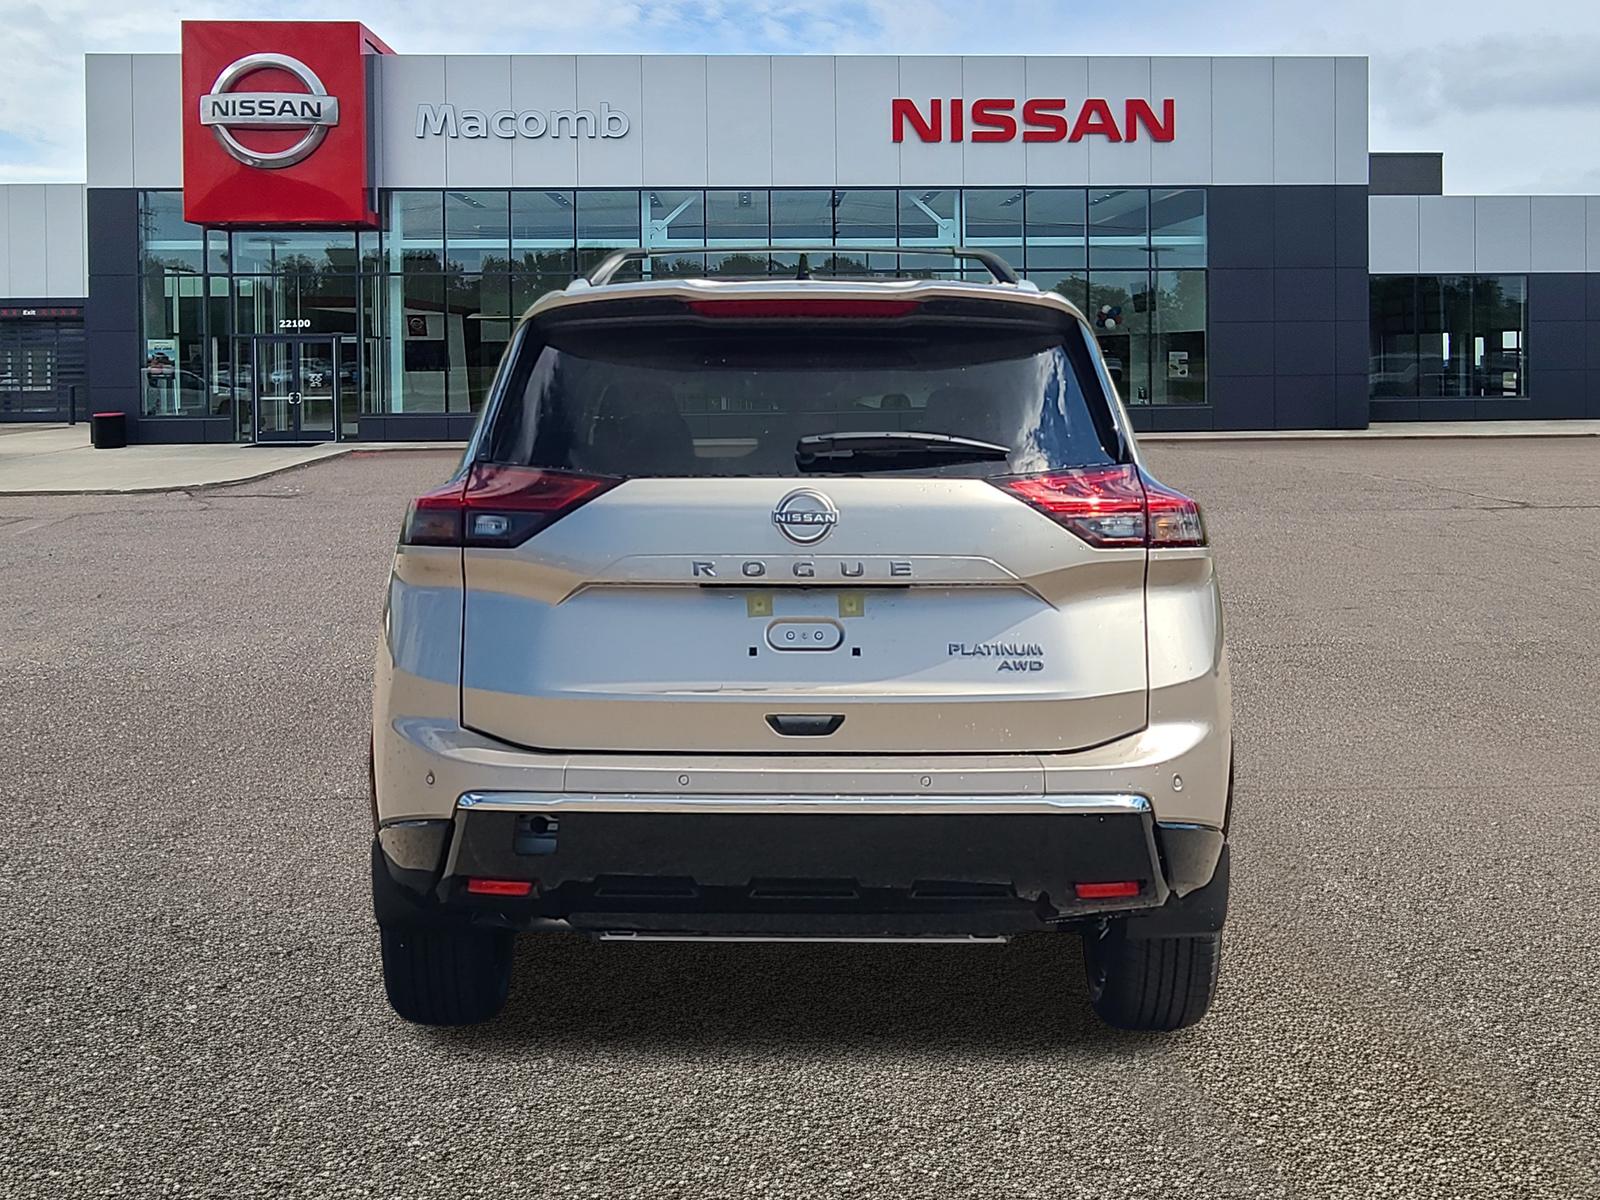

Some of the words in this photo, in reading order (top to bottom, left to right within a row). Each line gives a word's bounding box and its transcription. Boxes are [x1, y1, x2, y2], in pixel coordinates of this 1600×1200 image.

[211, 100, 323, 118] NISSAN
[415, 102, 630, 139] Macomb
[891, 98, 1176, 142] NISSAN
[279, 319, 311, 328] 22100
[775, 512, 837, 523] NISSAN
[692, 560, 913, 578] ROGUE
[948, 642, 1044, 657] PLATINUM
[997, 659, 1044, 672] AWD
